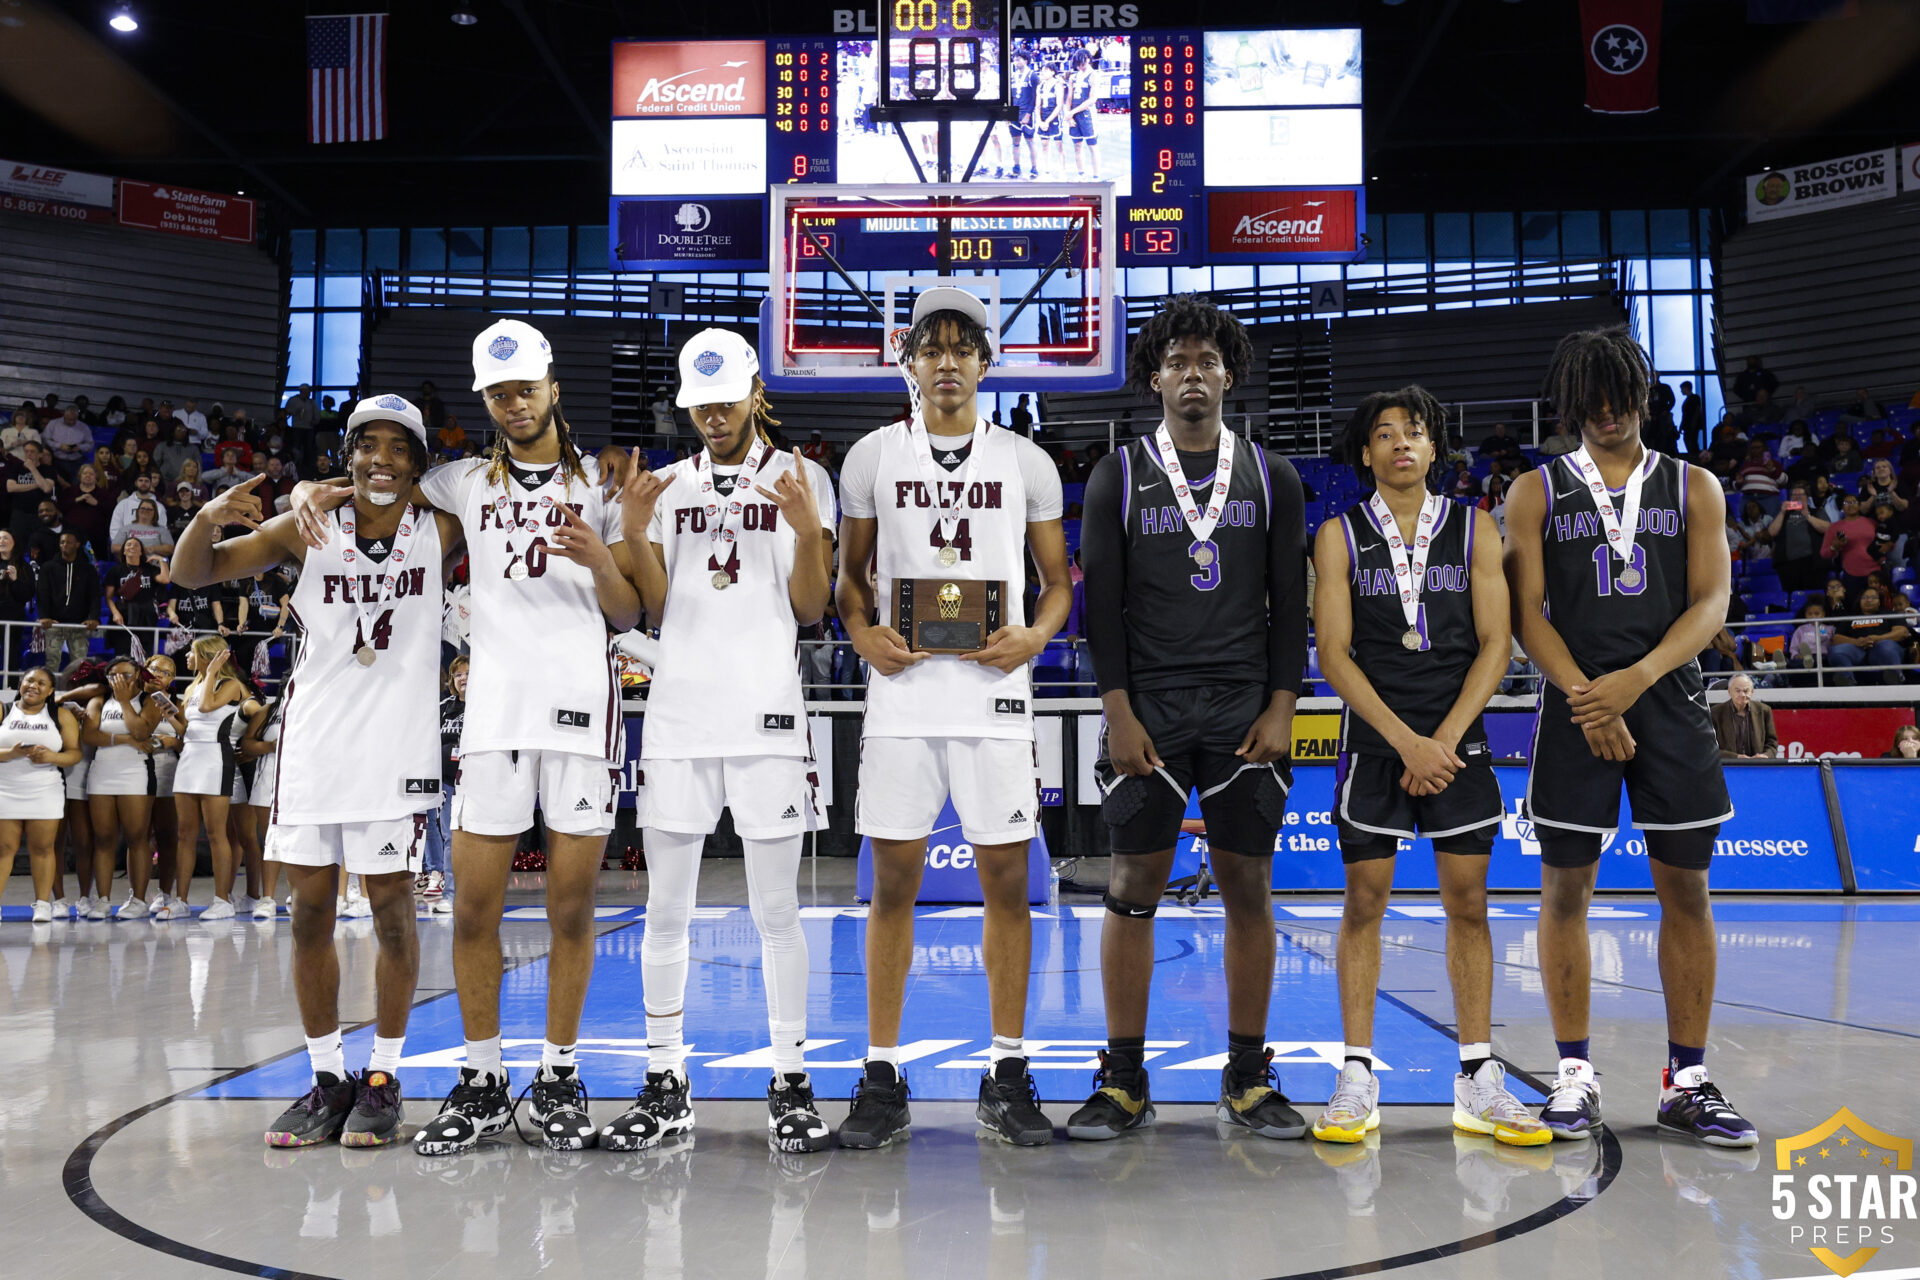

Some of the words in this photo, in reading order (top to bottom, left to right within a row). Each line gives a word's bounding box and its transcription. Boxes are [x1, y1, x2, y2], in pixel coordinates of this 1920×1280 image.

[833, 9, 876, 33] BL
[1010, 4, 1140, 30] AIDERS
[776, 53, 793, 66] 00
[800, 53, 808, 65] 0
[820, 53, 828, 65] 2
[1139, 46, 1157, 59] 00
[1164, 46, 1173, 58] 0
[1185, 45, 1193, 58] 0
[780, 69, 793, 82] 10
[800, 69, 808, 81] 0
[820, 69, 828, 81] 2
[1143, 63, 1157, 75] 14
[1164, 62, 1173, 75] 0
[1185, 62, 1193, 75] 0
[777, 86, 793, 99] 30
[804, 87, 808, 97] 1
[820, 86, 828, 98] 0
[1143, 79, 1157, 92] 15
[1164, 79, 1173, 92] 0
[1185, 79, 1193, 92] 0
[636, 103, 673, 112] Federal
[676, 103, 707, 112] Credit
[710, 103, 741, 111] Union
[777, 103, 793, 115] 32
[800, 102, 808, 115] 0
[820, 102, 828, 114] 0
[1140, 96, 1157, 109] 20
[1164, 96, 1173, 109] 0
[1185, 96, 1193, 108] 0
[776, 119, 793, 132] 40
[800, 119, 808, 131] 0
[820, 119, 828, 131] 0
[1141, 113, 1157, 126] 34
[1164, 113, 1173, 125] 0
[1185, 112, 1194, 125] 0
[658, 159, 695, 171] Saint
[700, 159, 758, 171] Thomas
[794, 156, 806, 176] 8
[1159, 149, 1172, 170] 8
[32, 168, 68, 183] LEE
[1793, 154, 1885, 184] ROSCOE
[1152, 172, 1165, 193] 2
[1793, 170, 1885, 200] BROWN
[0, 195, 87, 220] 5.867.1000
[1129, 208, 1183, 222] HAYWOOD
[163, 211, 185, 223] Deb
[866, 218, 919, 232] MIDDLE
[926, 217, 1007, 231] TENESSEE
[1145, 231, 1173, 252] 52
[1232, 236, 1263, 244] Federal
[1294, 235, 1320, 243] Union
[1013, 245, 1023, 257] 4
[659, 289, 675, 308] T
[1318, 287, 1338, 307] A
[783, 368, 816, 376] SPALDING
[895, 481, 1003, 509] FULTON
[675, 503, 779, 535] FUON
[1141, 500, 1257, 535] HAYOOD
[1555, 508, 1679, 543] HAYOOD
[930, 518, 972, 561] 44
[1188, 538, 1221, 591] 3
[1592, 542, 1648, 597] 13
[1357, 564, 1468, 597] HAYOOD
[9, 720, 49, 731] Falcons
[1287, 834, 1330, 851] the
[1712, 839, 1809, 856] nessee
